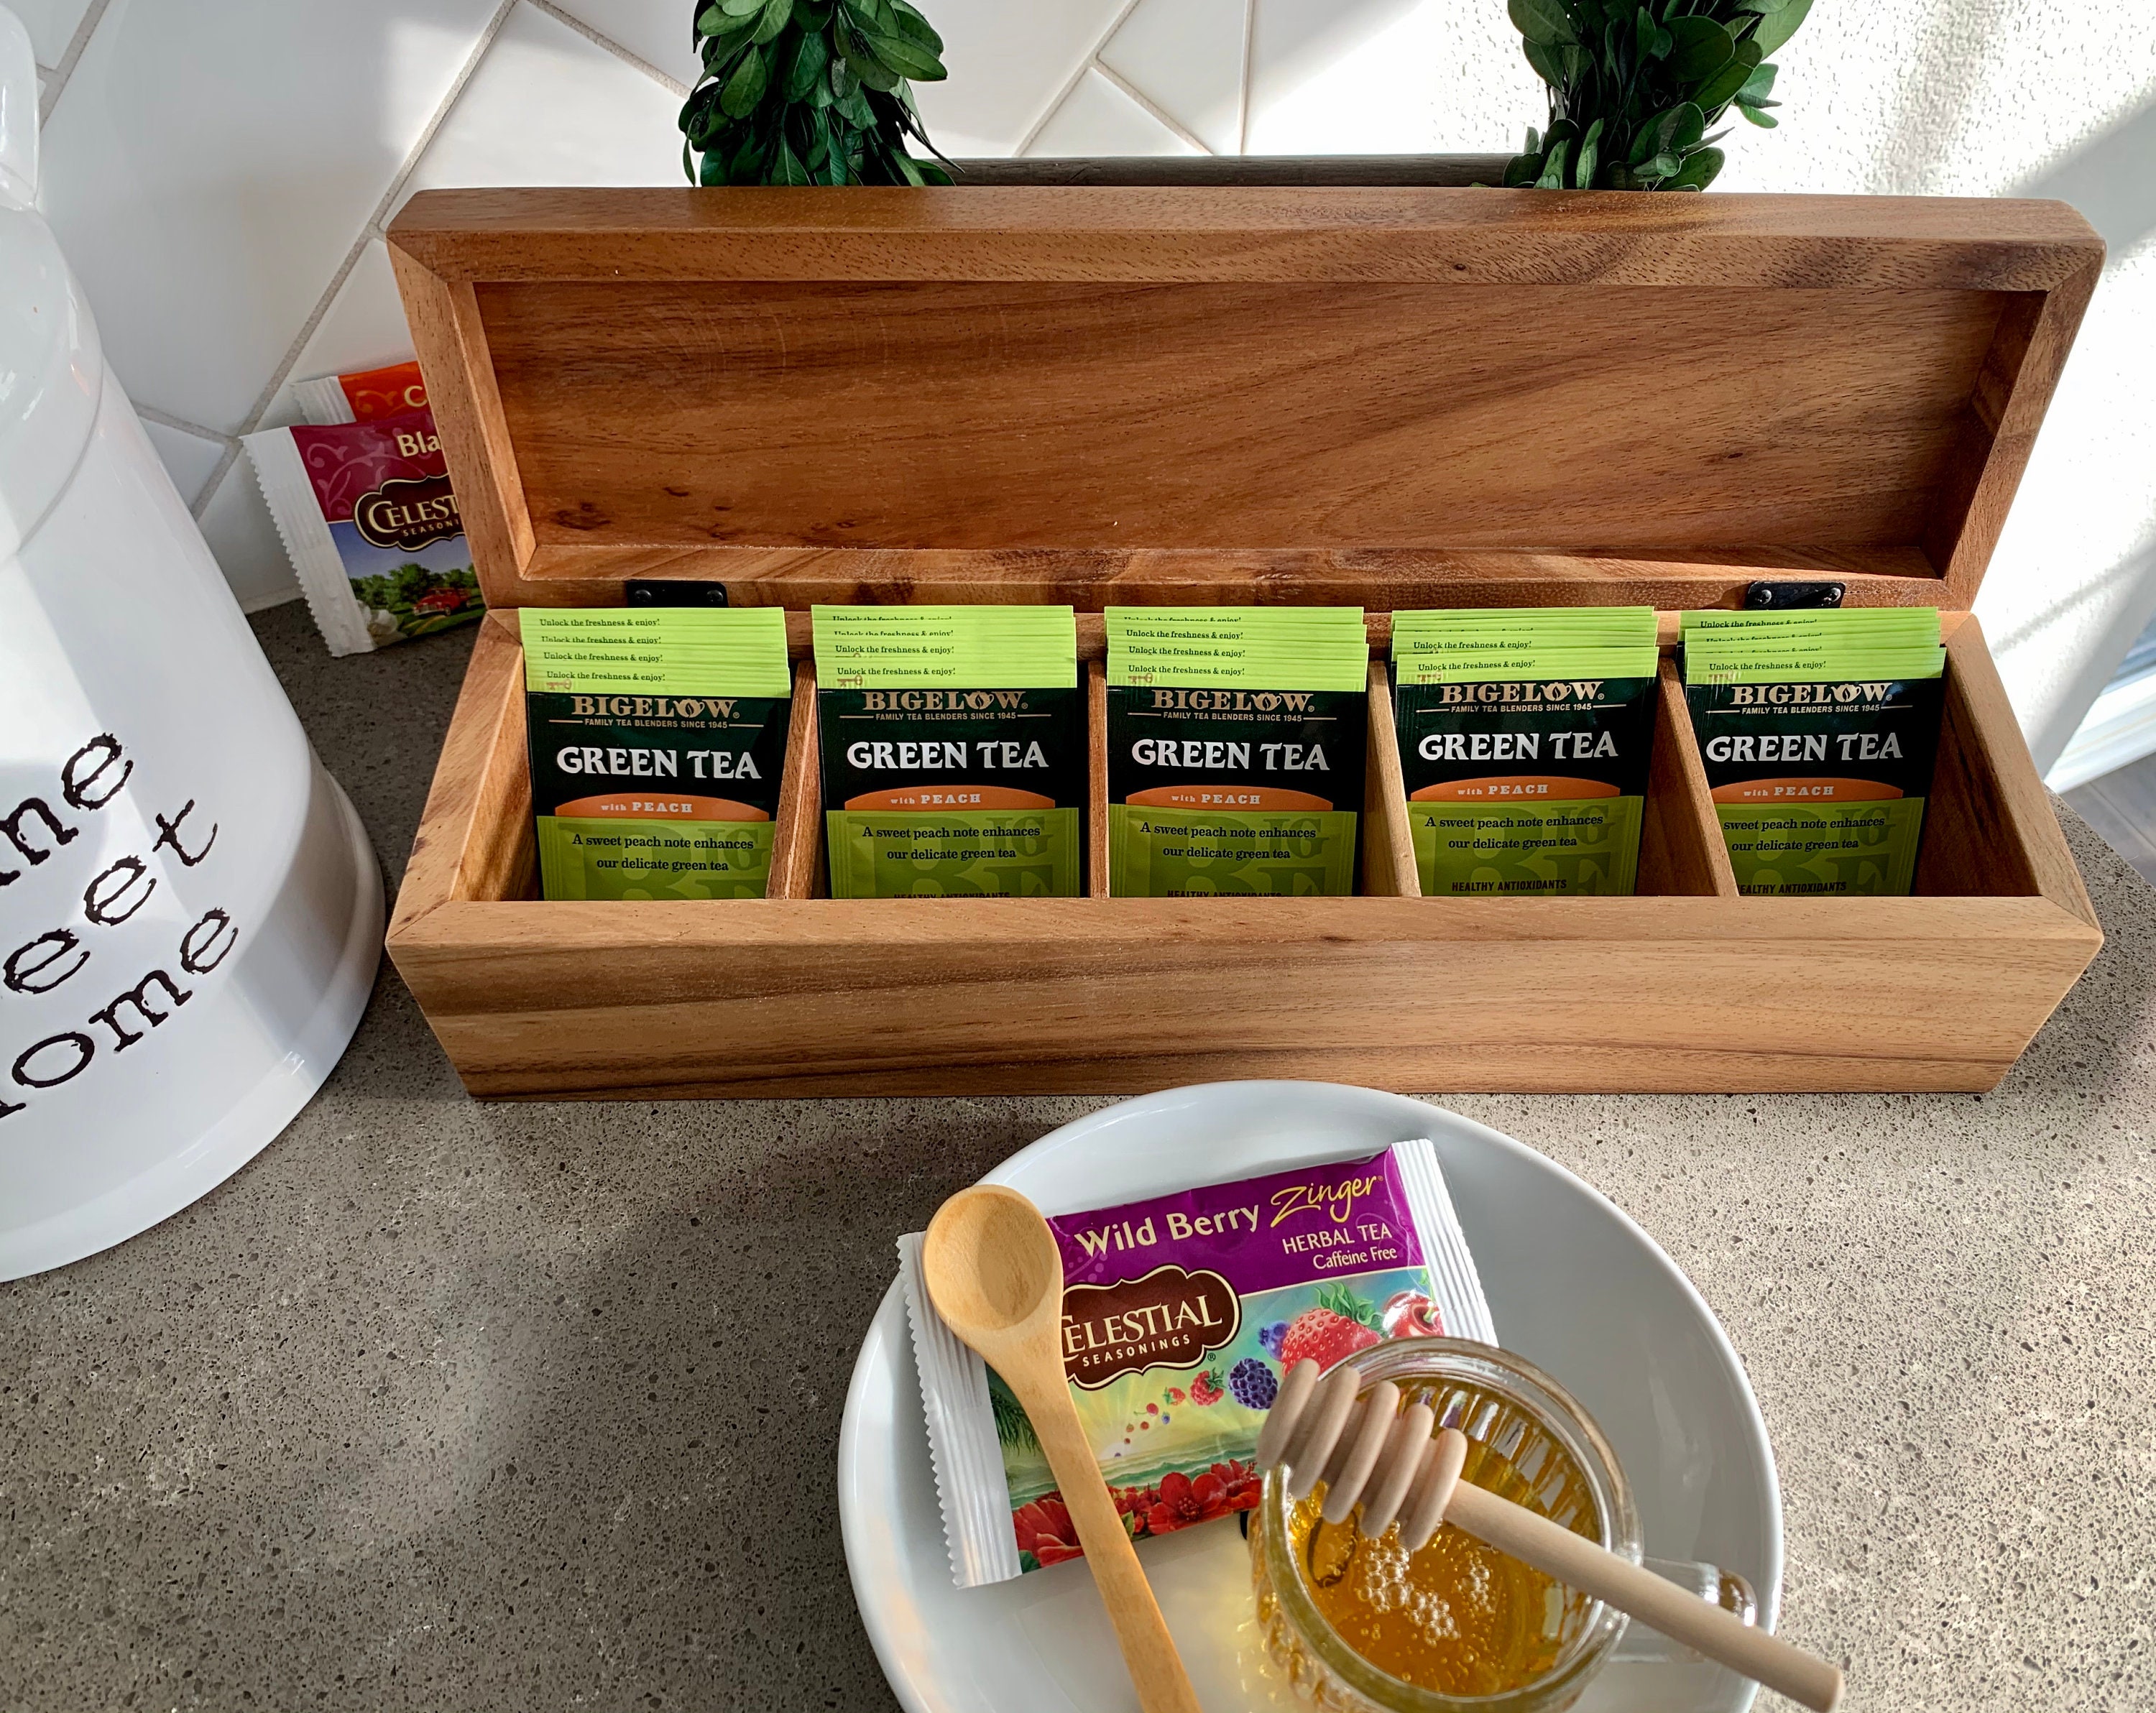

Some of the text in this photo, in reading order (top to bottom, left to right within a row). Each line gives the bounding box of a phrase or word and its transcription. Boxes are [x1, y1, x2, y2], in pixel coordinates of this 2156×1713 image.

[1151, 690, 1314, 711] BIGELOW
[1439, 682, 1603, 703] BIGELOW
[1730, 683, 1893, 705] BIGELOW
[571, 696, 738, 718] BIGELOW
[862, 691, 1026, 711] BIGELOW
[1419, 731, 1618, 761] GREEN TEA
[1706, 732, 1903, 762] GREEN TEA
[847, 741, 1049, 769] GREEN TEA
[1132, 739, 1330, 770] GREEN TEA
[557, 747, 762, 779] GREEN TEA
[1488, 785, 1548, 795] PEACH
[1774, 786, 1834, 795] PEACH
[921, 794, 981, 804] PEACH
[1202, 795, 1261, 804] PEACH
[632, 803, 693, 813] PEACH
[1141, 822, 1316, 839] A sweet peach note enhances
[1424, 816, 1603, 830] A sweet peach note enhances
[1723, 817, 1884, 831] sweet peach note enhances
[862, 826, 1040, 840] A sweet peach note enhances
[573, 834, 754, 850] A sweet peach note enhances
[1448, 837, 1577, 849] our delicate green tea
[1731, 839, 1858, 852] our delicate green tea
[887, 849, 1016, 861] our delicate green tea
[1163, 846, 1290, 860] our delicate green tea
[596, 858, 729, 872] our delicate green tea
[1452, 879, 1567, 892] HEALTHY ANTIOXIDANTS
[1779, 882, 1846, 893] ANTIOXIDANTS
[0, 907, 239, 1118] ome
[1075, 1175, 1377, 1257] Wild Berry Zinger
[1282, 1223, 1392, 1256] HERBAL TEA
[1312, 1245, 1398, 1270] Caffeine Free
[1083, 1334, 1190, 1367] SEASONINGS
